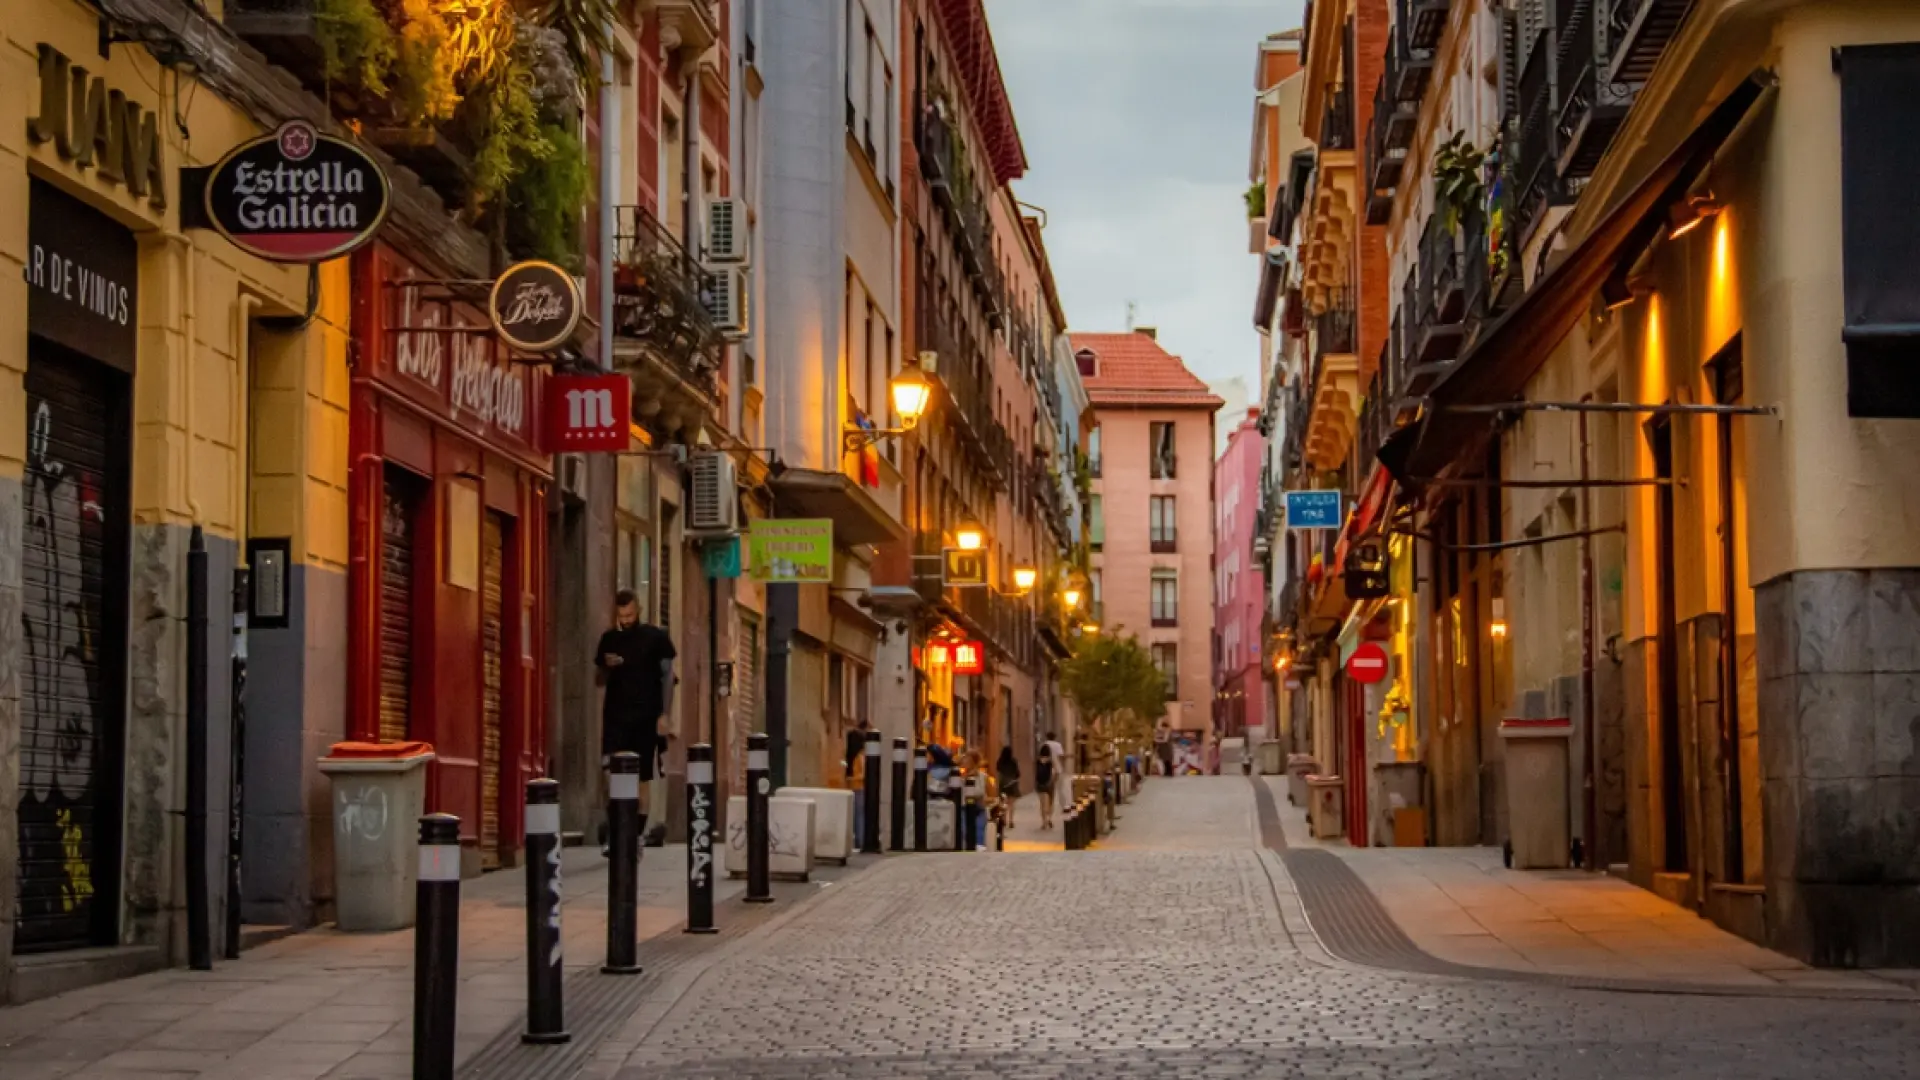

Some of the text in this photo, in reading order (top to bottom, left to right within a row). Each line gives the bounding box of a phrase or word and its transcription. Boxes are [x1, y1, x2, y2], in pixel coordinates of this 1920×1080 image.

[27, 42, 167, 214] JUANA
[232, 160, 364, 195] Estrella
[237, 194, 358, 229] Galicia
[50, 251, 73, 301] DE
[78, 265, 129, 327] VINOS
